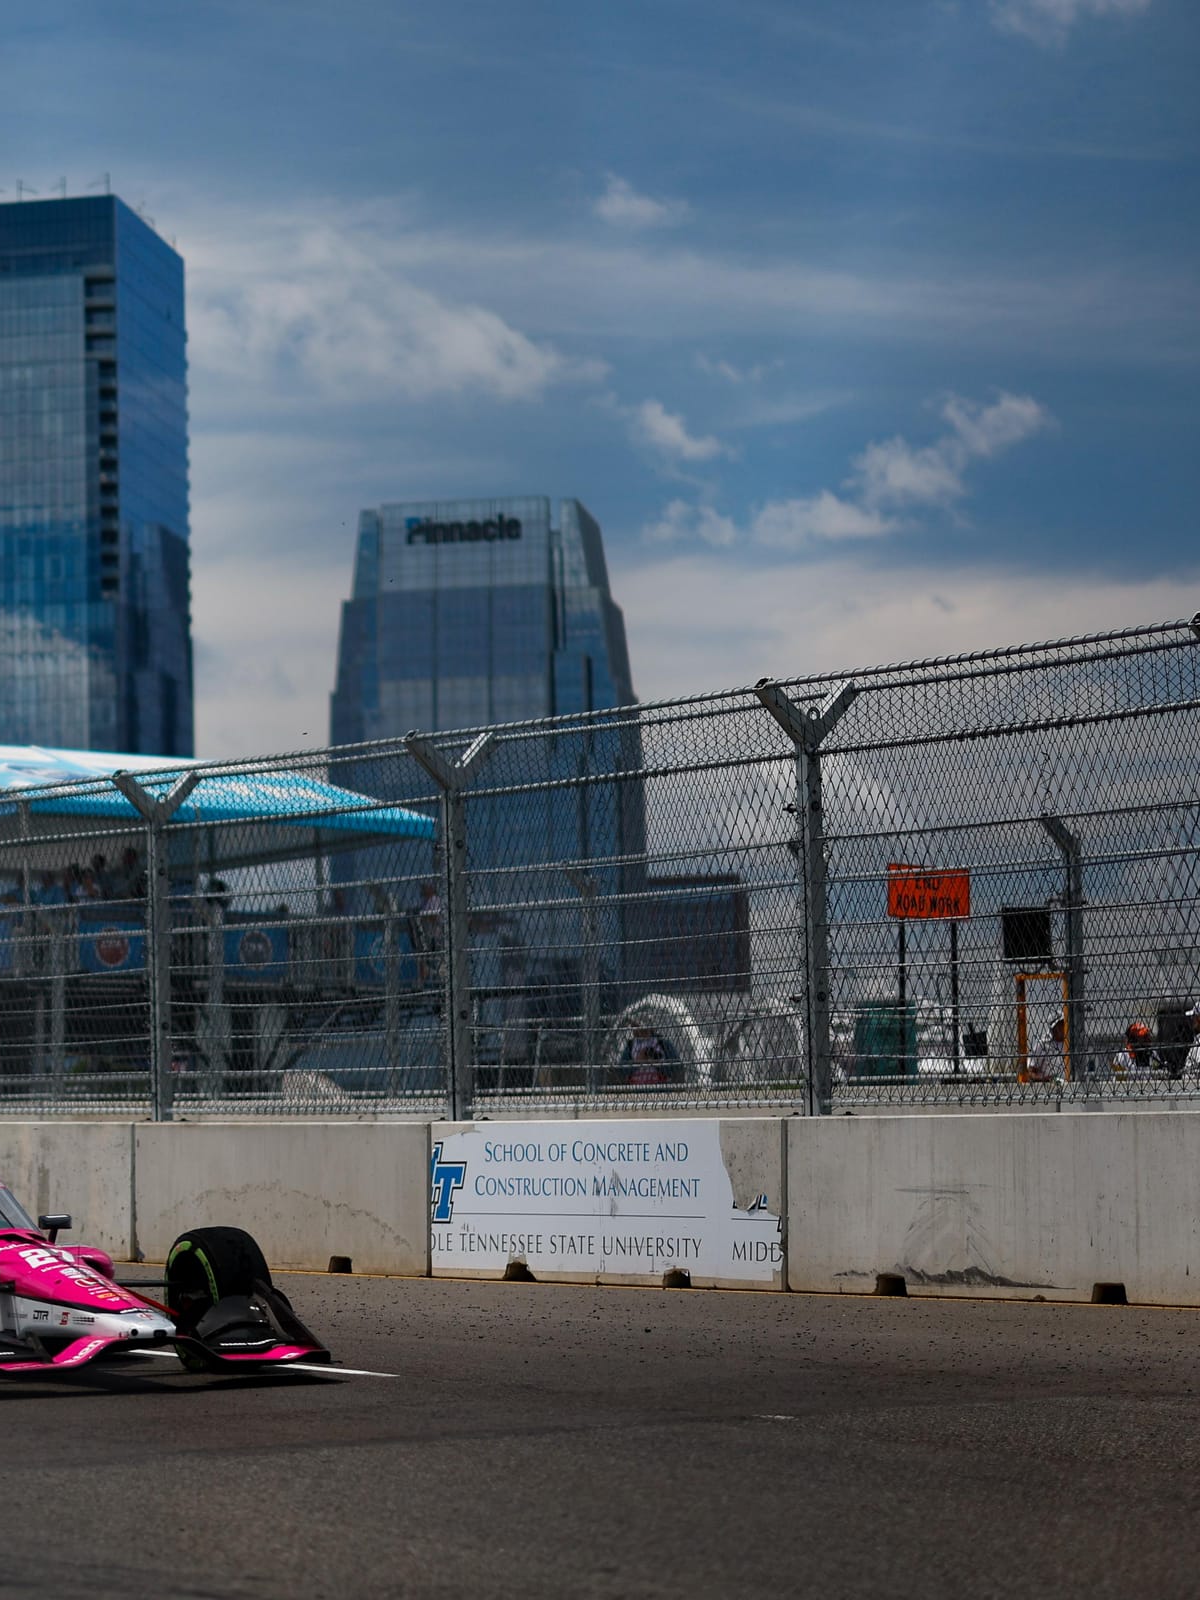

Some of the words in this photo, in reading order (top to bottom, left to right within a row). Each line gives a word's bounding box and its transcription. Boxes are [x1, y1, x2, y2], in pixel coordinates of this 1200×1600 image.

[405, 512, 521, 545] Pinnacle
[930, 896, 960, 913] WORK
[484, 1141, 544, 1162] SCHOOL
[548, 1143, 567, 1162] OF
[572, 1140, 650, 1162] CONCRETE
[655, 1143, 688, 1162] AND
[475, 1175, 587, 1197] CONSTRUCTION
[592, 1175, 701, 1198] MANAGEMENT
[459, 1233, 543, 1253] TENNESSEE
[550, 1234, 595, 1255] STATE
[602, 1236, 702, 1258] UNIVERSITY
